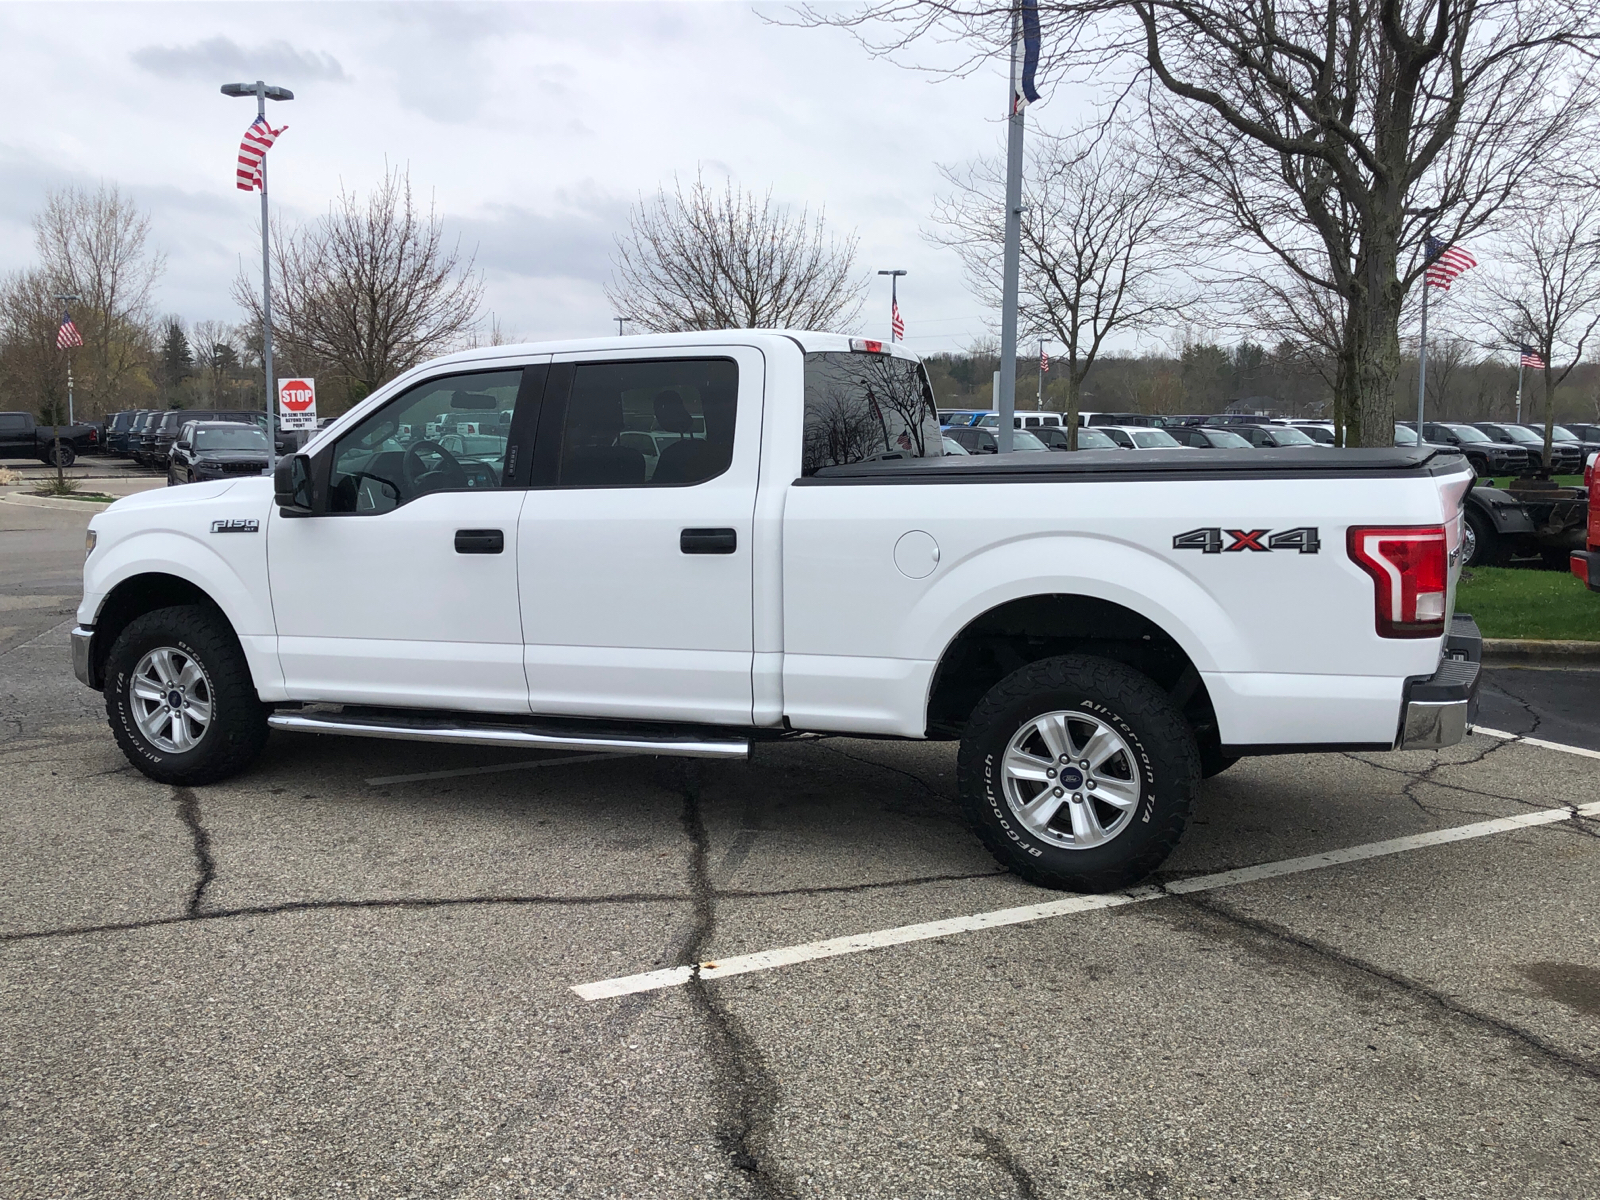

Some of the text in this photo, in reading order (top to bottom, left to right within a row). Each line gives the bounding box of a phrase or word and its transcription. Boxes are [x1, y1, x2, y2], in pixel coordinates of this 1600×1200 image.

[282, 389, 312, 403] STOP
[116, 672, 124, 694] T/A
[1080, 700, 1156, 824] All-Terrain T/A
[984, 753, 1043, 858] BFGoodrich
